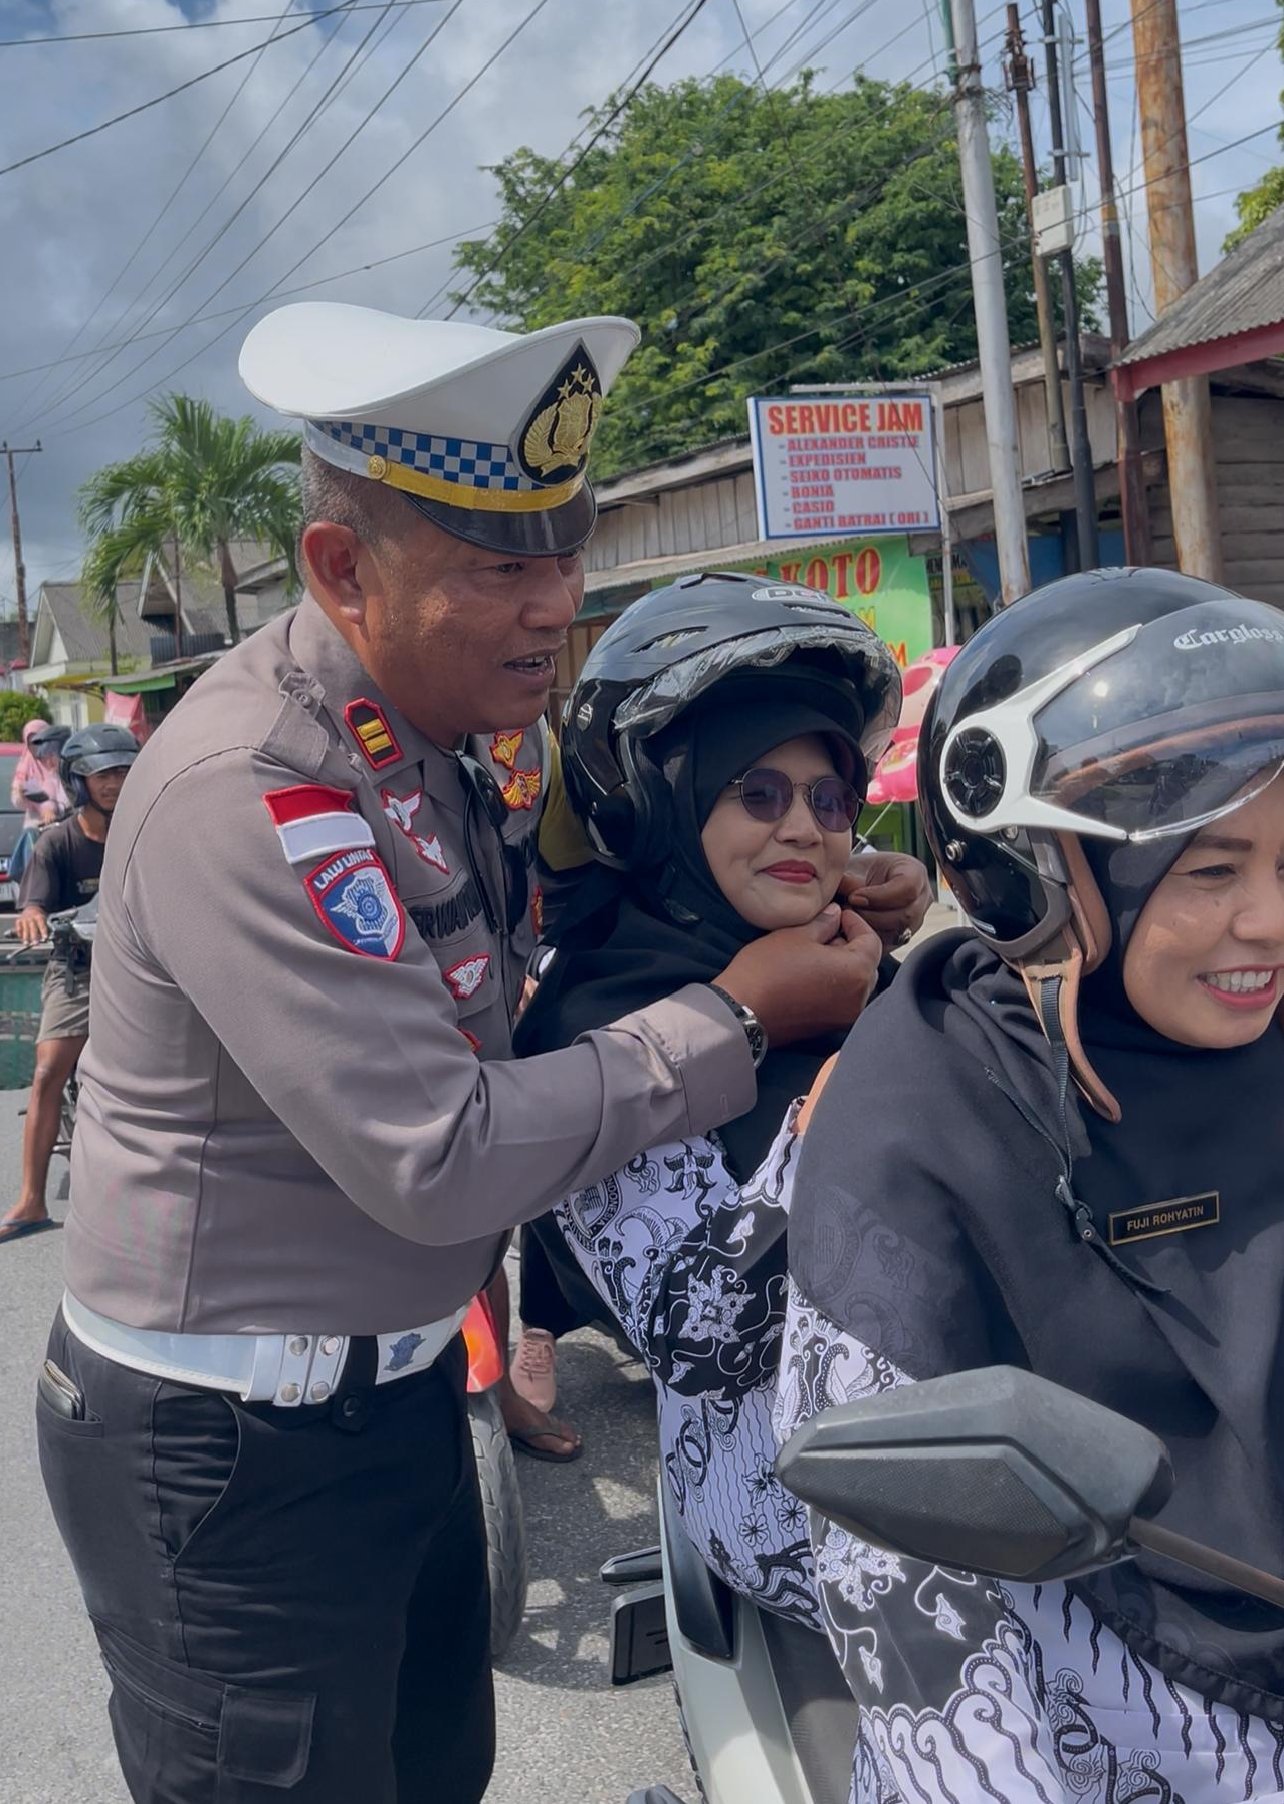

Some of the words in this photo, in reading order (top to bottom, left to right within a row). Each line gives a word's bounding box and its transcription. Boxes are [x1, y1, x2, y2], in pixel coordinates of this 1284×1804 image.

[768, 404, 872, 435] SERVICE
[877, 403, 922, 431] JAM
[788, 437, 864, 451] ALEXANDER
[790, 469, 830, 482] SEIKO
[833, 467, 902, 480] OTOMATIS
[793, 501, 834, 514] CASIO
[794, 516, 835, 530] GANTI
[838, 513, 886, 527] BATRAI
[313, 860, 344, 889] LALU
[1127, 1217, 1149, 1231] FUJI
[1152, 1205, 1204, 1226] ROHYATIN
